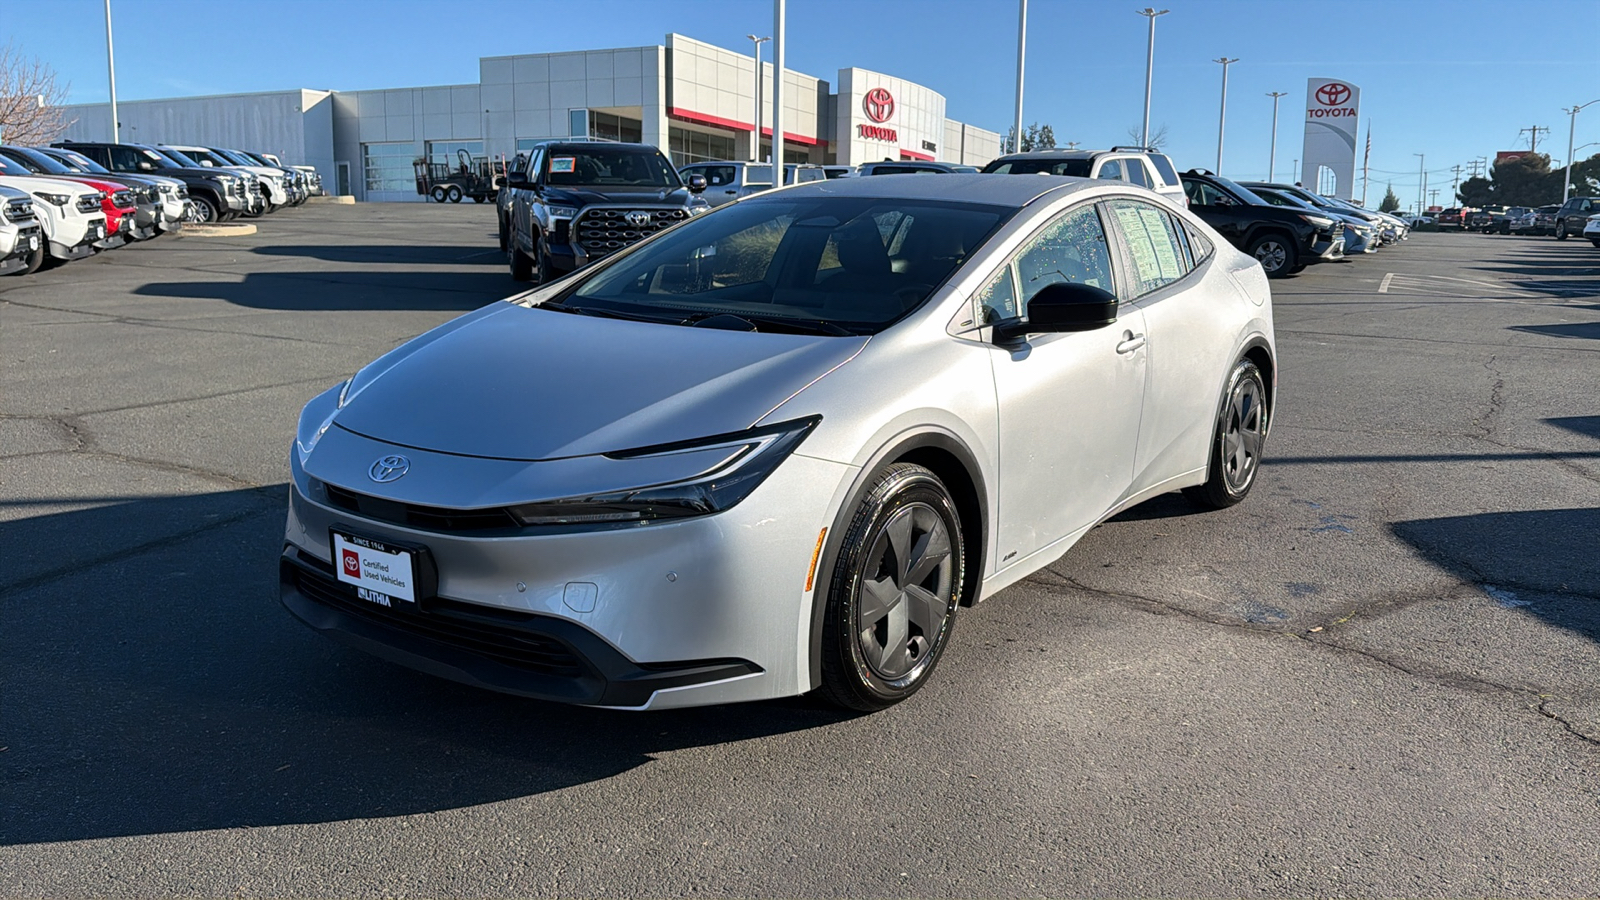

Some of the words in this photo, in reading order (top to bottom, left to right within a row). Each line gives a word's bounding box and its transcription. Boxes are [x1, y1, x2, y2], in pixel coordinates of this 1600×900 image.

[1308, 107, 1356, 118] TOYOTA
[858, 124, 897, 142] TOYOTA
[352, 536, 369, 548] SINCE
[370, 541, 385, 551] 1946
[363, 558, 389, 572] Certified
[364, 569, 379, 581] Used
[380, 572, 405, 588] Vehicles
[365, 589, 392, 608] LITHIA
